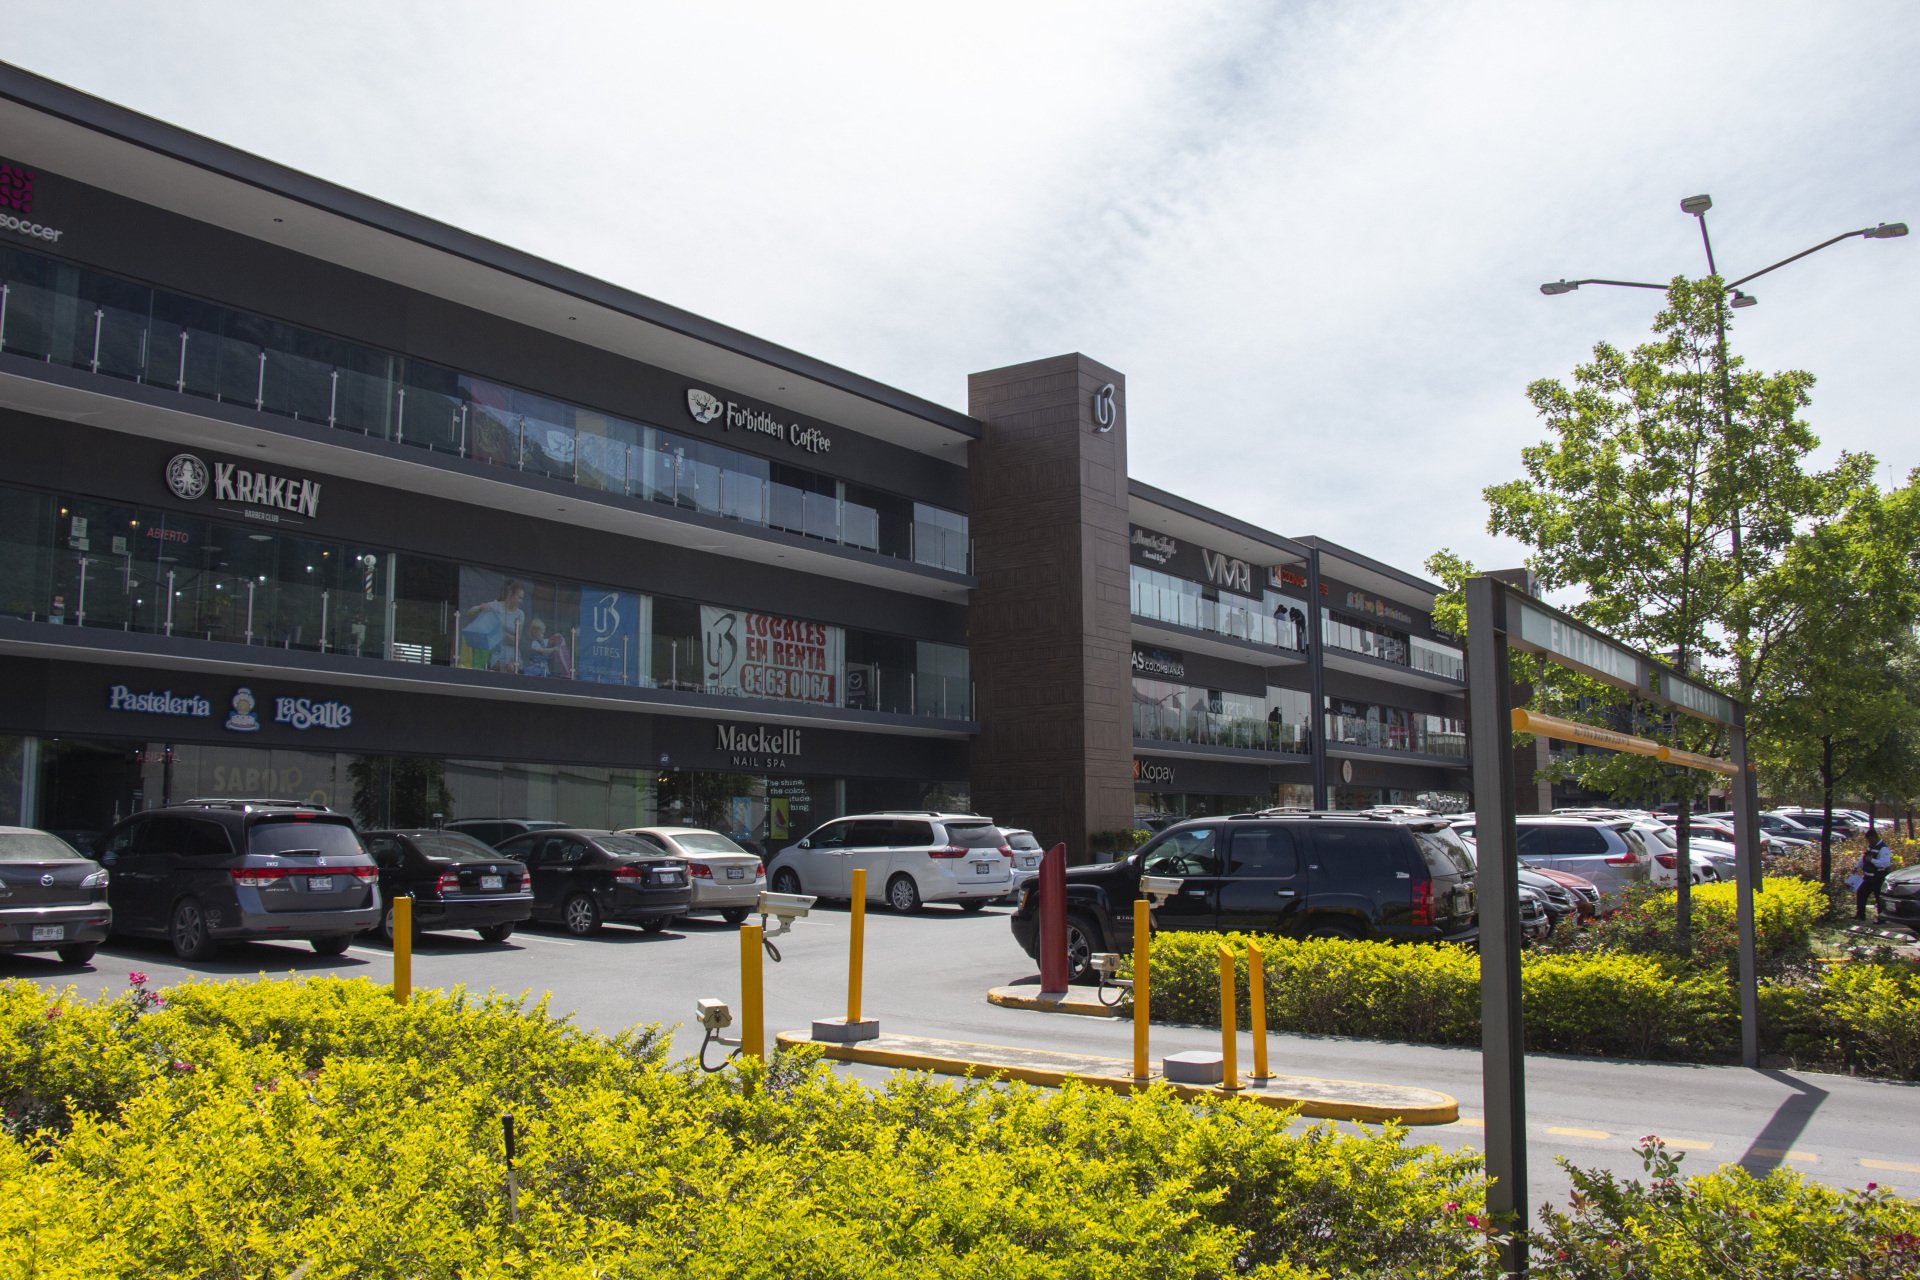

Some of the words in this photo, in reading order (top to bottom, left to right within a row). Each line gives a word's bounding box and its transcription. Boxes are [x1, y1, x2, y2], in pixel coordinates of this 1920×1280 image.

[0, 213, 64, 242] soccer
[727, 401, 784, 440] Forbidden
[790, 423, 831, 454] Coffee
[213, 462, 322, 519] KRAKEN
[244, 509, 265, 521] BARBER
[265, 512, 280, 523] CLUB
[147, 527, 190, 544] ABIERTO
[745, 613, 827, 647] LOCALES
[592, 645, 621, 659] UTRES
[745, 636, 768, 663] EN
[772, 640, 827, 672] RENTA
[1551, 619, 1620, 679] ENTRADA
[1145, 660, 1185, 678] COLOMBIANAS
[743, 665, 787, 697] 8363
[790, 671, 830, 701] 0064
[109, 684, 211, 718] Pastelería
[1210, 699, 1254, 718] KRYPTN
[716, 724, 801, 756] Mackelli
[136, 752, 178, 764] ABIERT
[733, 756, 759, 767] NAIL
[766, 758, 786, 769] SPA
[1141, 761, 1176, 784] Kopay
[770, 787, 783, 795] the
